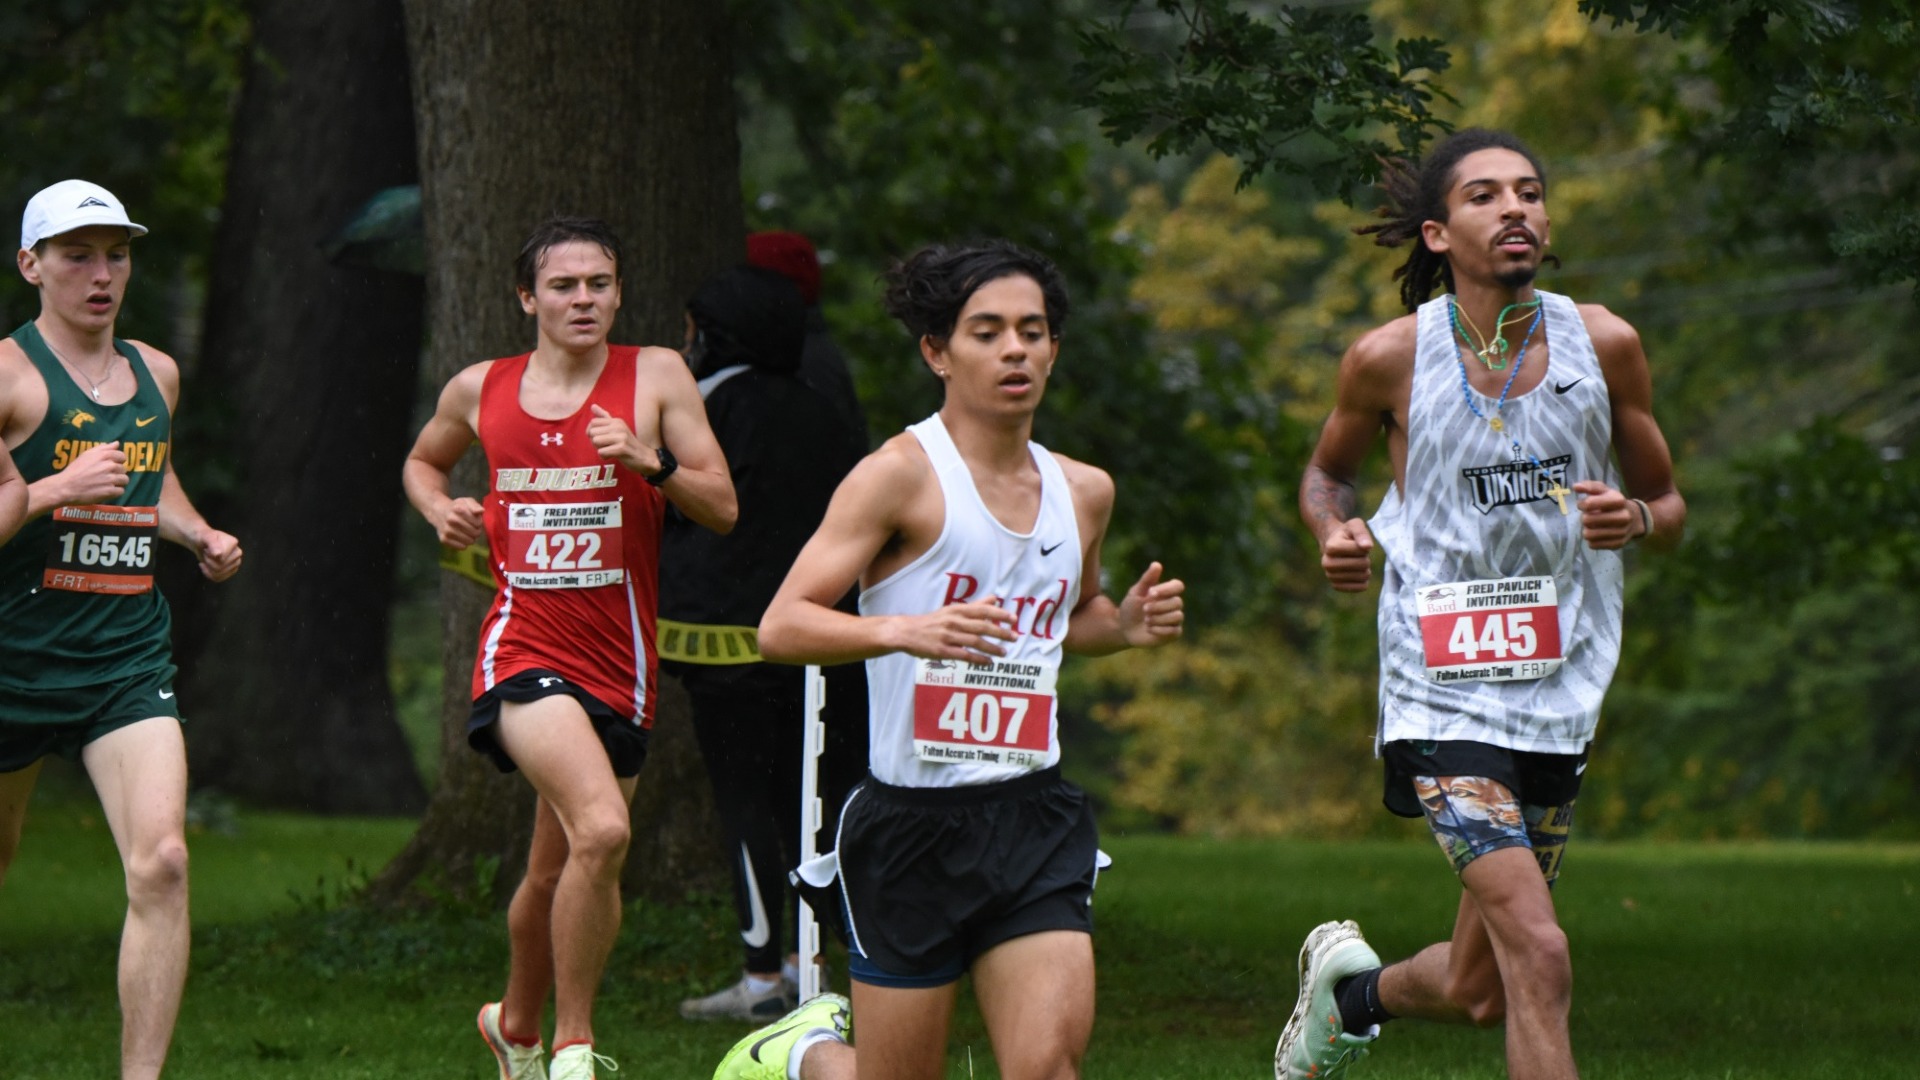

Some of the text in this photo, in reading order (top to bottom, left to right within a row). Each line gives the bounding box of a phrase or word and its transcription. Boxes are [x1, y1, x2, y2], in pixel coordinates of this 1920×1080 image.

[1465, 456, 1569, 475] HUDSON VLLEY
[1468, 464, 1568, 514] VIKINGS
[61, 506, 92, 520] Fulton
[93, 509, 132, 522] Accurate
[544, 506, 609, 516] FRED PAVLICH
[514, 517, 535, 528] Bard
[542, 516, 606, 527] INVITATIONAL
[59, 532, 152, 568] 16545
[525, 532, 602, 570] 422
[559, 575, 579, 585] Timing
[1467, 580, 1542, 595] FRED PAVLICH
[1427, 600, 1456, 613] Bard
[1466, 592, 1540, 608] INVITATIONAL
[1448, 612, 1537, 660] 445
[997, 662, 1042, 677] PAVLICH
[1436, 666, 1513, 681] Fulton Accurate Timing
[925, 672, 955, 684] Bard
[964, 674, 1036, 690] INVITATIONAL
[938, 692, 1029, 744] 407
[923, 746, 999, 763] Fulton Accurate Timing
